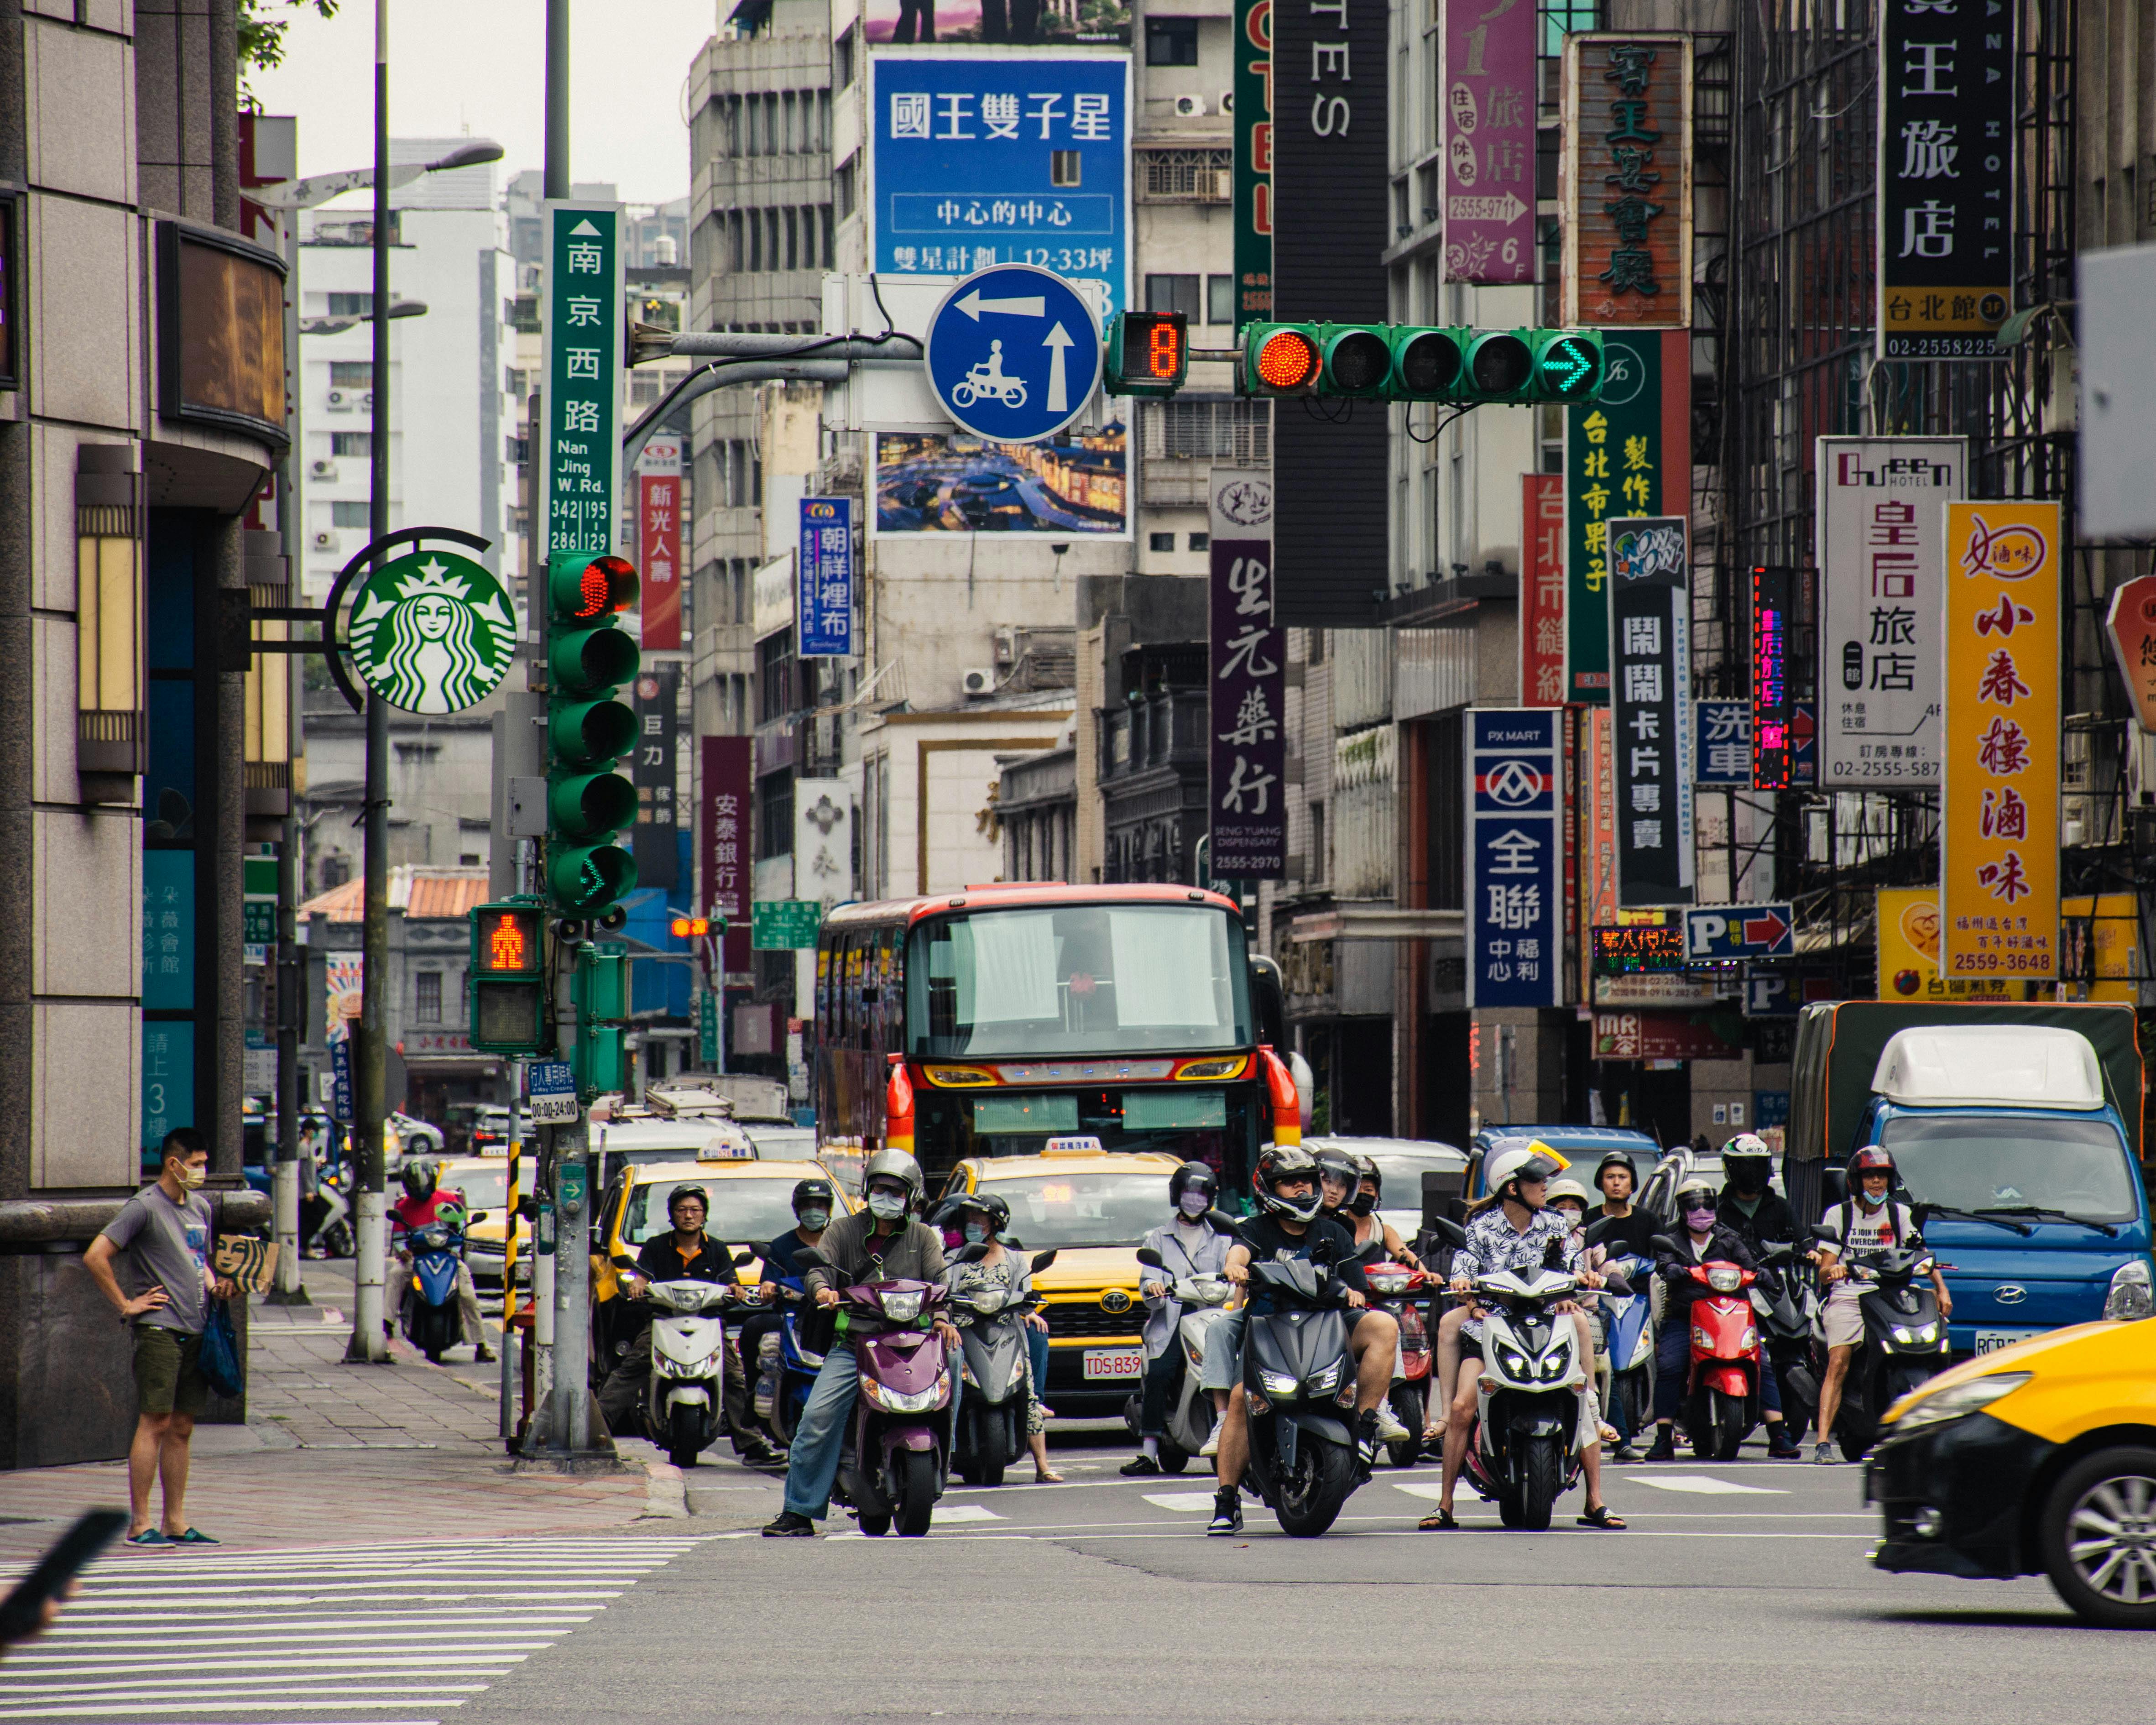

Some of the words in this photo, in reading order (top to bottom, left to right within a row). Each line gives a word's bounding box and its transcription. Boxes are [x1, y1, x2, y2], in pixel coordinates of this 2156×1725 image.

[890, 93, 1111, 140] 國王雙子星
[1452, 89, 1475, 127] 住宿
[1485, 86, 1524, 182] 旅店
[1452, 141, 1475, 179] 休息
[1451, 199, 1516, 217] 2555-9711
[1984, 121, 2000, 258] HOTEL
[937, 199, 1071, 227] 中心的中心
[893, 246, 996, 271] 雙星計劃
[1023, 247, 1112, 272] 12-33坪
[1889, 294, 1976, 320] 台北館
[564, 241, 602, 433] 南京西路
[1151, 324, 1177, 376] 8
[1889, 339, 2007, 355] 02-2558225
[558, 440, 587, 455] Nan
[558, 460, 590, 477] Jing
[558, 478, 576, 492] W.
[580, 477, 605, 493] Rd.
[1890, 476, 1929, 486] HOTEL
[552, 501, 577, 518] 342
[585, 501, 607, 519] 195
[551, 532, 576, 549] 286
[585, 533, 606, 550] 129
[650, 484, 672, 583] 新光人壽
[821, 527, 848, 636] 朝祥裡布
[1869, 501, 1919, 691] 皇后旅店
[1217, 557, 1278, 815] 生元藥行
[1842, 703, 1865, 714] 休息
[1842, 717, 1866, 728] 住宿
[643, 714, 663, 765] 巨力
[1488, 732, 1504, 741] PX
[1506, 731, 1541, 741] MART
[1624, 617, 1662, 848] 鬧鬧卡片專賣
[1706, 706, 1750, 776] 洗車
[1977, 594, 2031, 904] 小春樓滷味
[715, 794, 738, 889] 安泰銀行
[1216, 856, 1280, 869] 2555-2970
[1488, 829, 1541, 930] 全聯
[161, 886, 179, 974] 朵薇會館
[1691, 915, 1727, 954] P
[1488, 938, 1512, 982] 中心
[1516, 938, 1540, 982] 福利
[1955, 953, 2050, 970] 2559-3648
[532, 1100, 575, 1118] 00:00-24:00
[1851, 1238, 1884, 1246] OVERCOME
